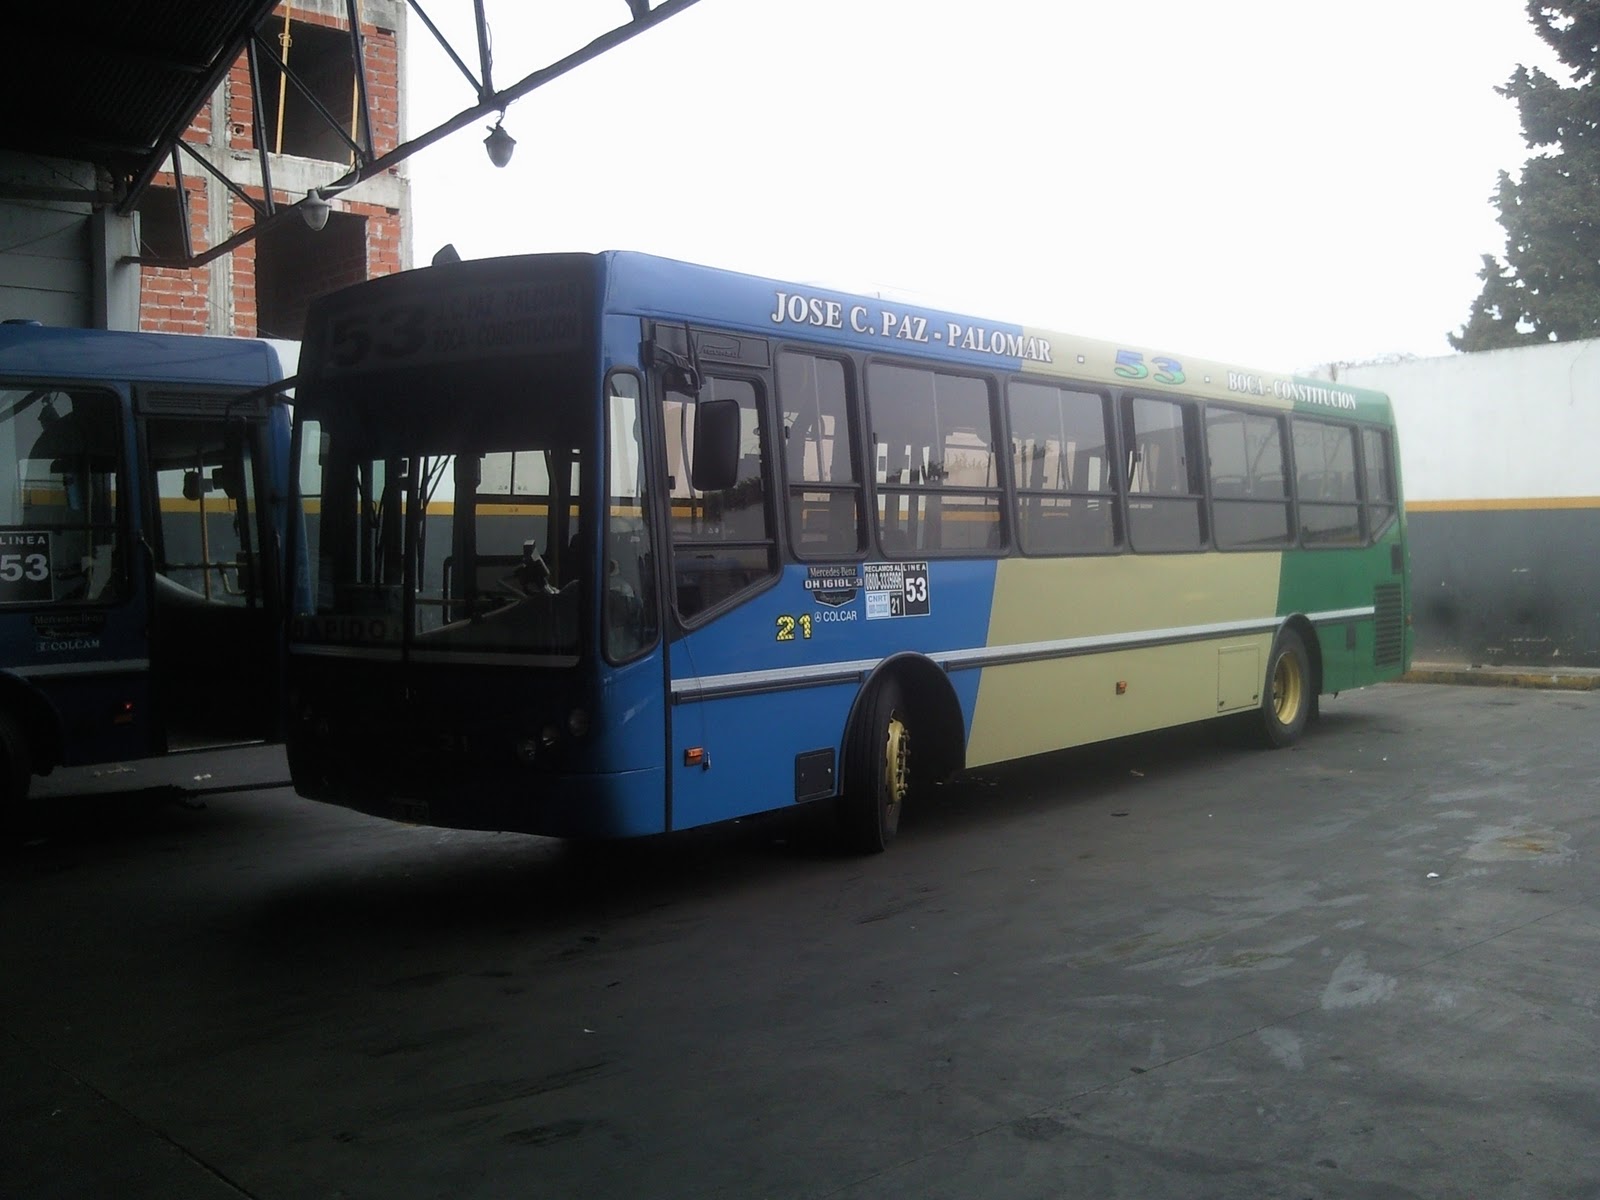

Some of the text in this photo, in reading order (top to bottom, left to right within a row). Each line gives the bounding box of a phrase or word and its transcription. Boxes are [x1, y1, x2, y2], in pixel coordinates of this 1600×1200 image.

[771, 292, 843, 330] JOSE
[850, 306, 875, 335] C.
[881, 311, 929, 343] PAZ
[947, 323, 1053, 363] PALOMAR
[1114, 350, 1186, 385] 53
[1228, 372, 1264, 395] BOCA
[1273, 379, 1357, 410] CONSTITUCION
[0, 536, 46, 545] LINEA
[0, 553, 49, 582] 53
[810, 567, 857, 577] Mercedes-Benz
[902, 563, 926, 571] LINEA
[905, 577, 927, 602] 53
[823, 611, 857, 622] COLCAR
[891, 598, 901, 614] 21
[776, 614, 812, 641] 21
